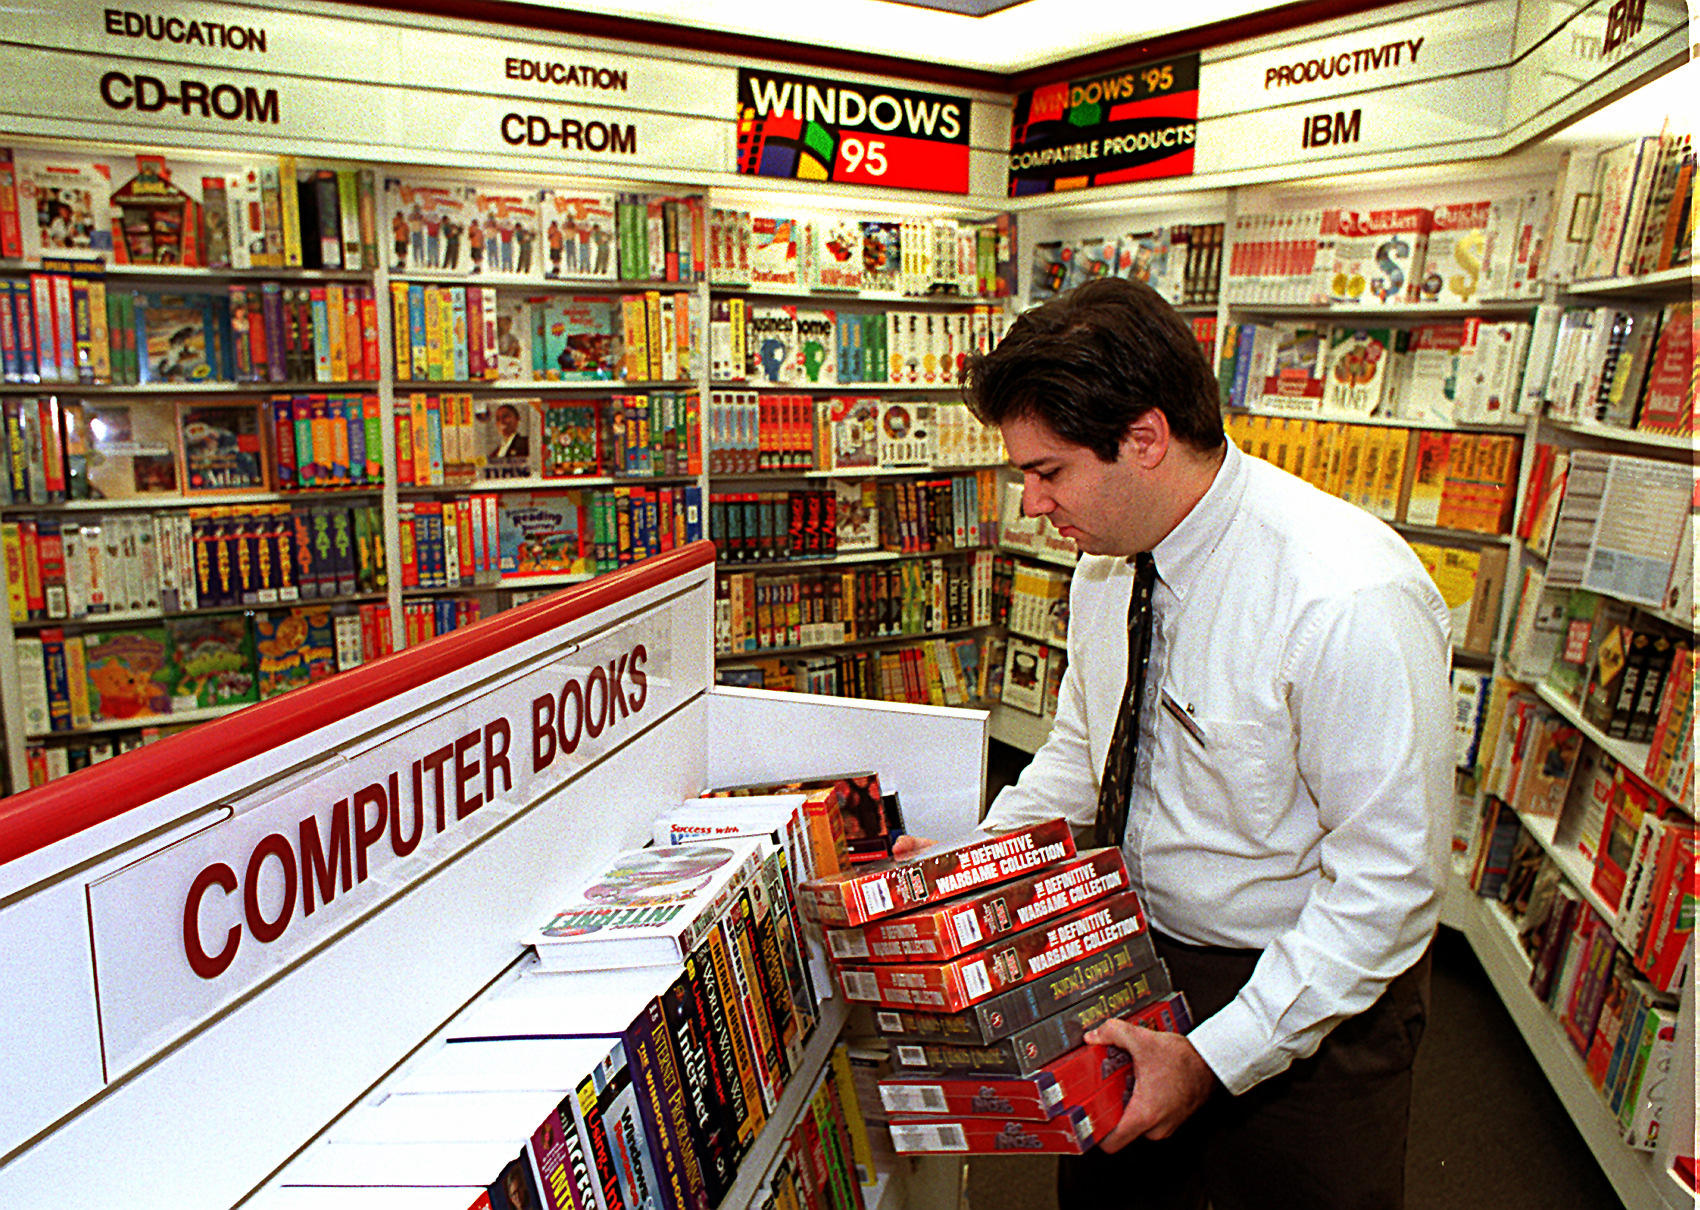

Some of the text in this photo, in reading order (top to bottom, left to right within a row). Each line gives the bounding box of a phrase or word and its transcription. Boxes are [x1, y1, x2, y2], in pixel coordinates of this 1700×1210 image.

[104, 9, 267, 53] EDUCATION
[1603, 0, 1646, 56] IBM
[505, 57, 628, 90] EDUCATION
[1264, 37, 1425, 90] PRODUCTIVITY
[100, 71, 280, 124] CD-ROM
[749, 77, 961, 139] WINDOWS
[1032, 75, 1134, 116] WINDOWS
[501, 113, 636, 154] CD-ROM
[1009, 123, 1197, 171] COMPATIBLE PRODUCTS
[1302, 109, 1363, 149] IBM
[840, 138, 888, 176] 95
[183, 644, 648, 980] COMPUTER BOOKS
[670, 824, 739, 834] Success with
[935, 864, 998, 894] WARGAME
[999, 842, 1066, 877] COLLECTION
[959, 834, 1034, 869] THE DEFINITIVE
[1017, 870, 1122, 924] WARGAME COLLECTION
[1034, 863, 1097, 898] THE DEFINITIVE
[540, 904, 686, 934] INTERNET
[1028, 916, 1139, 974] WARGAME COLLECTION
[1048, 908, 1113, 947] THE DEFINITIVE
[725, 916, 748, 996] SPORTS
[713, 941, 748, 1071] INTERNET BUSINESS
[691, 980, 725, 1106] Using Netscape
[693, 1041, 709, 1088] The
[702, 960, 744, 1122] WORLD WIDE WEB
[677, 1020, 709, 1129] Internet
[639, 1040, 649, 1066] THE
[645, 1068, 668, 1150] WINDOWS
[665, 1149, 674, 1173] 95
[651, 1020, 702, 1194] INTERNET PROGRAMMING
[587, 1107, 609, 1170] Using
[613, 1119, 640, 1207] Resource
[622, 1105, 649, 1202] Windows
